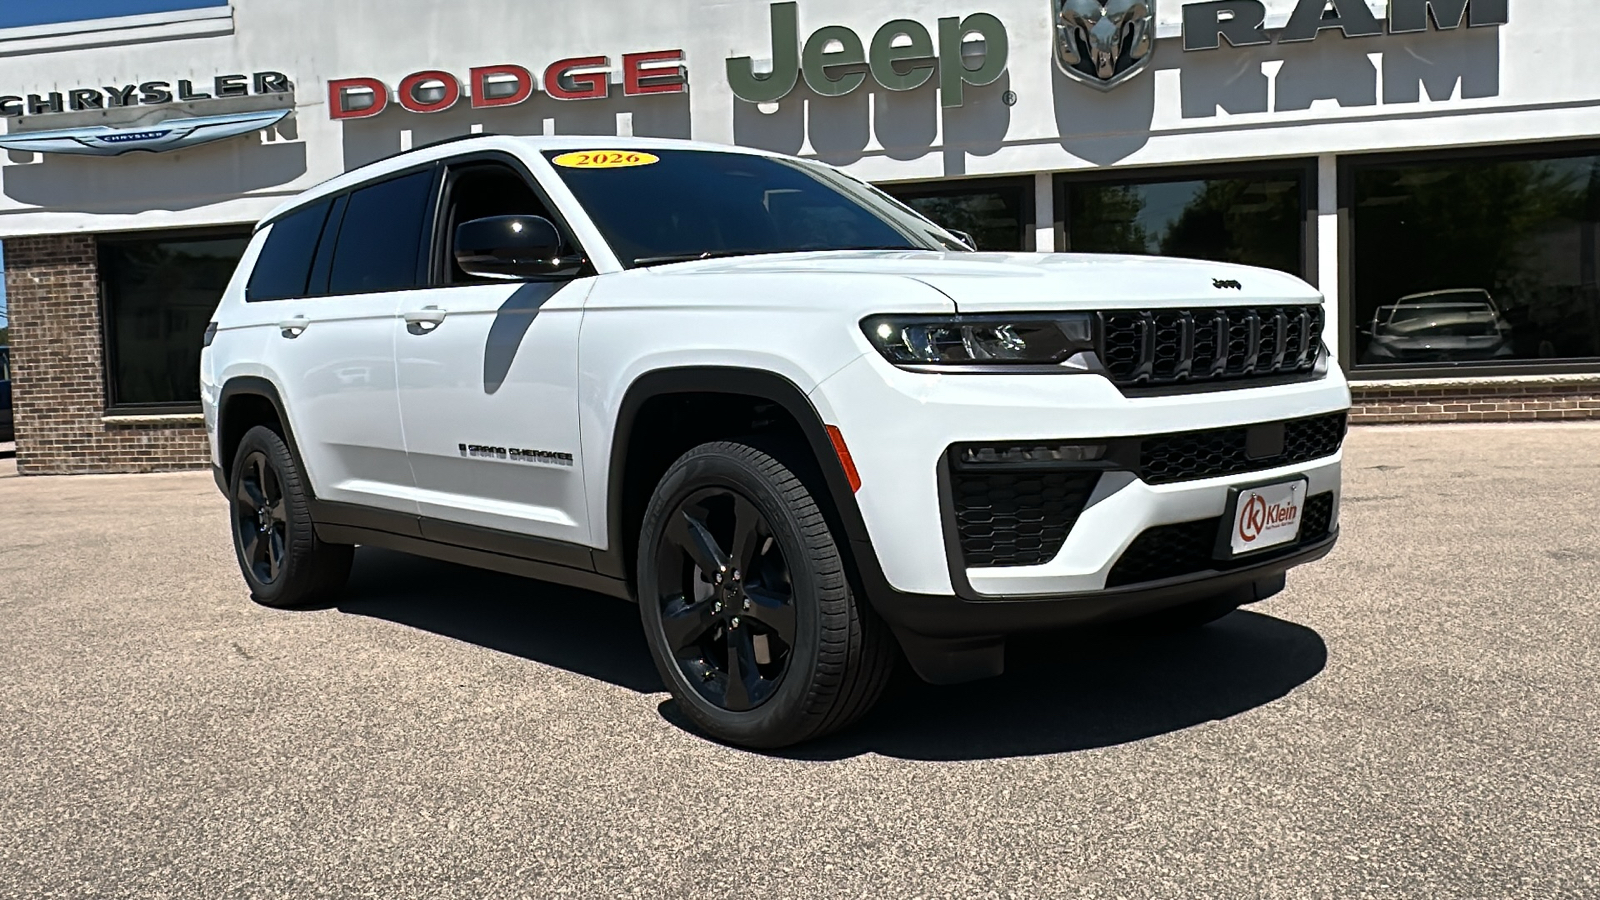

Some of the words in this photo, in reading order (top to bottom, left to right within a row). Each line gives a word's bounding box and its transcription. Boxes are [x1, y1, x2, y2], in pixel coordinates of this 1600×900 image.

[1183, 0, 1508, 51] RAM
[726, 1, 1008, 108] Jeep
[0, 71, 292, 118] CHRYSLER
[327, 48, 688, 120] DODGE
[104, 132, 162, 141] CHRYSLER
[576, 153, 640, 165] 2026
[1266, 501, 1297, 525] Klein
